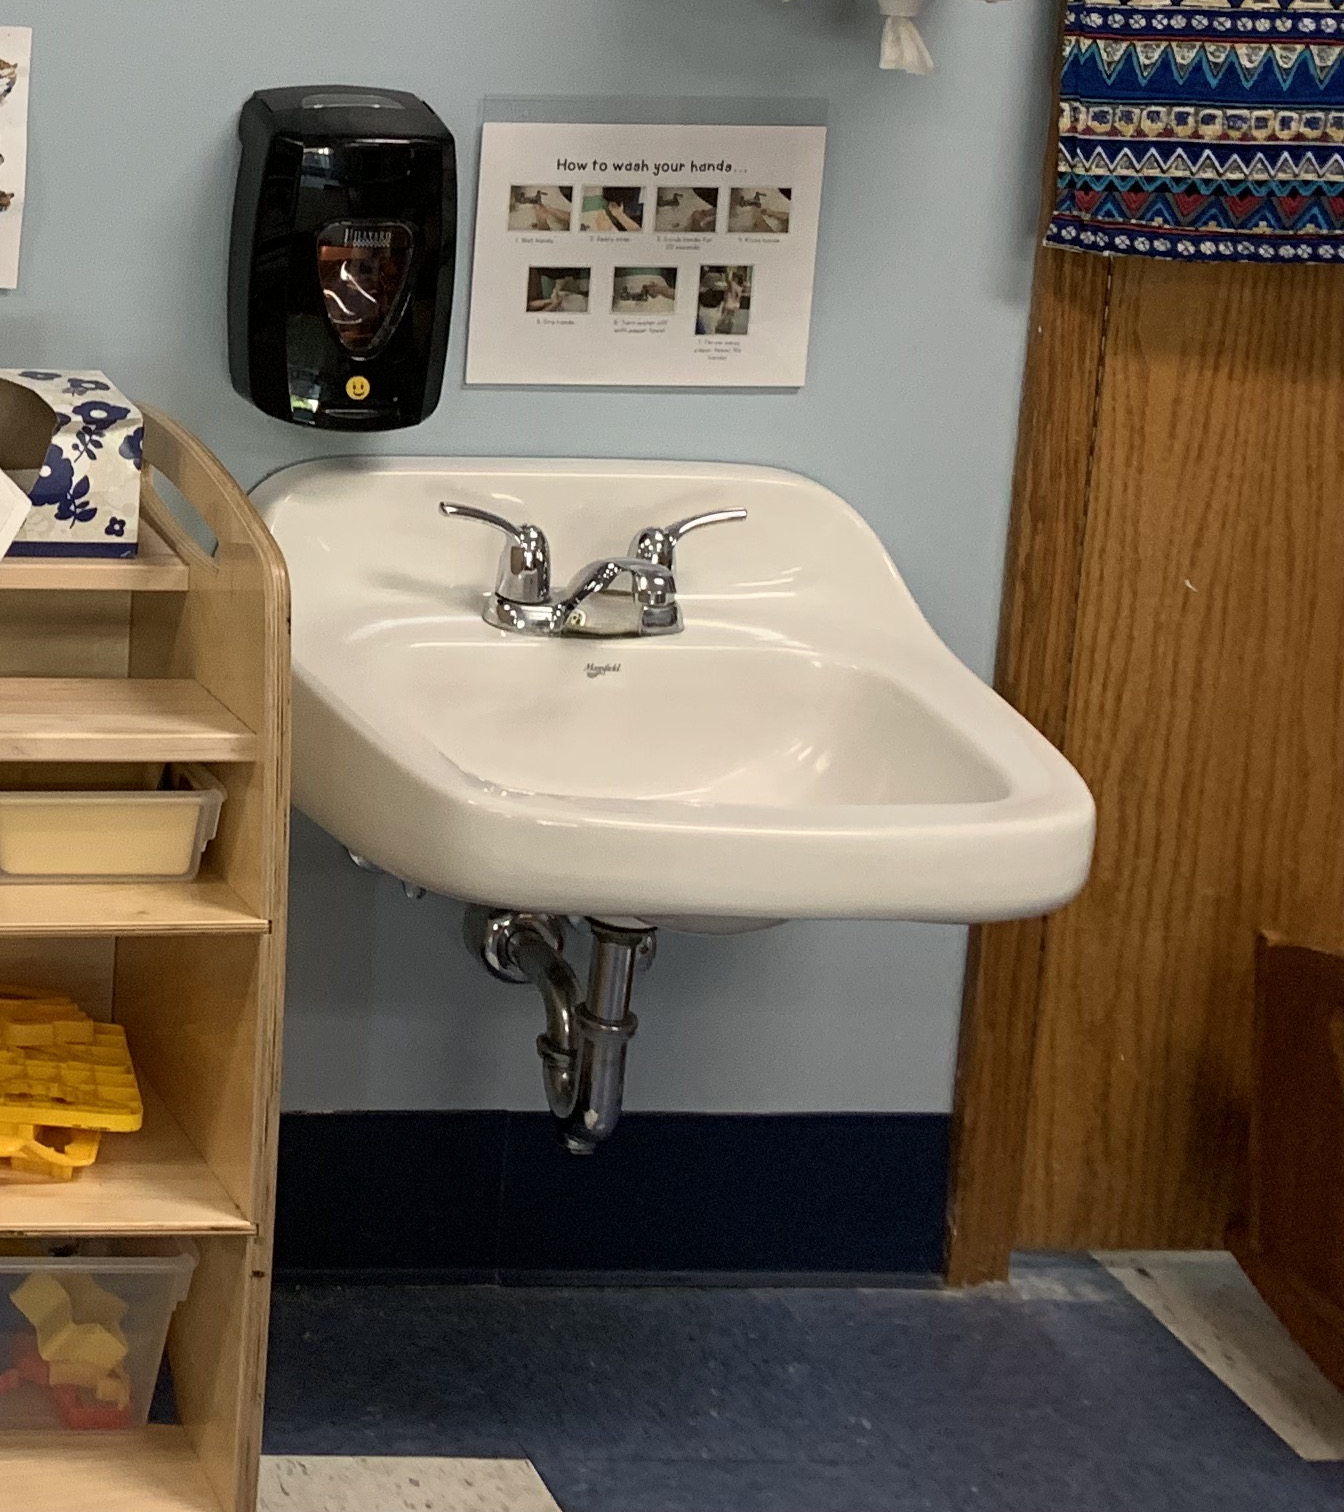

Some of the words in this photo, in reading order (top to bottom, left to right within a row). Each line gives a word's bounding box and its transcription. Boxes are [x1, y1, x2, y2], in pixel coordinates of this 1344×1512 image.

[556, 157, 588, 172] How
[592, 158, 608, 172] to
[612, 158, 649, 172] wash
[653, 161, 685, 176] your
